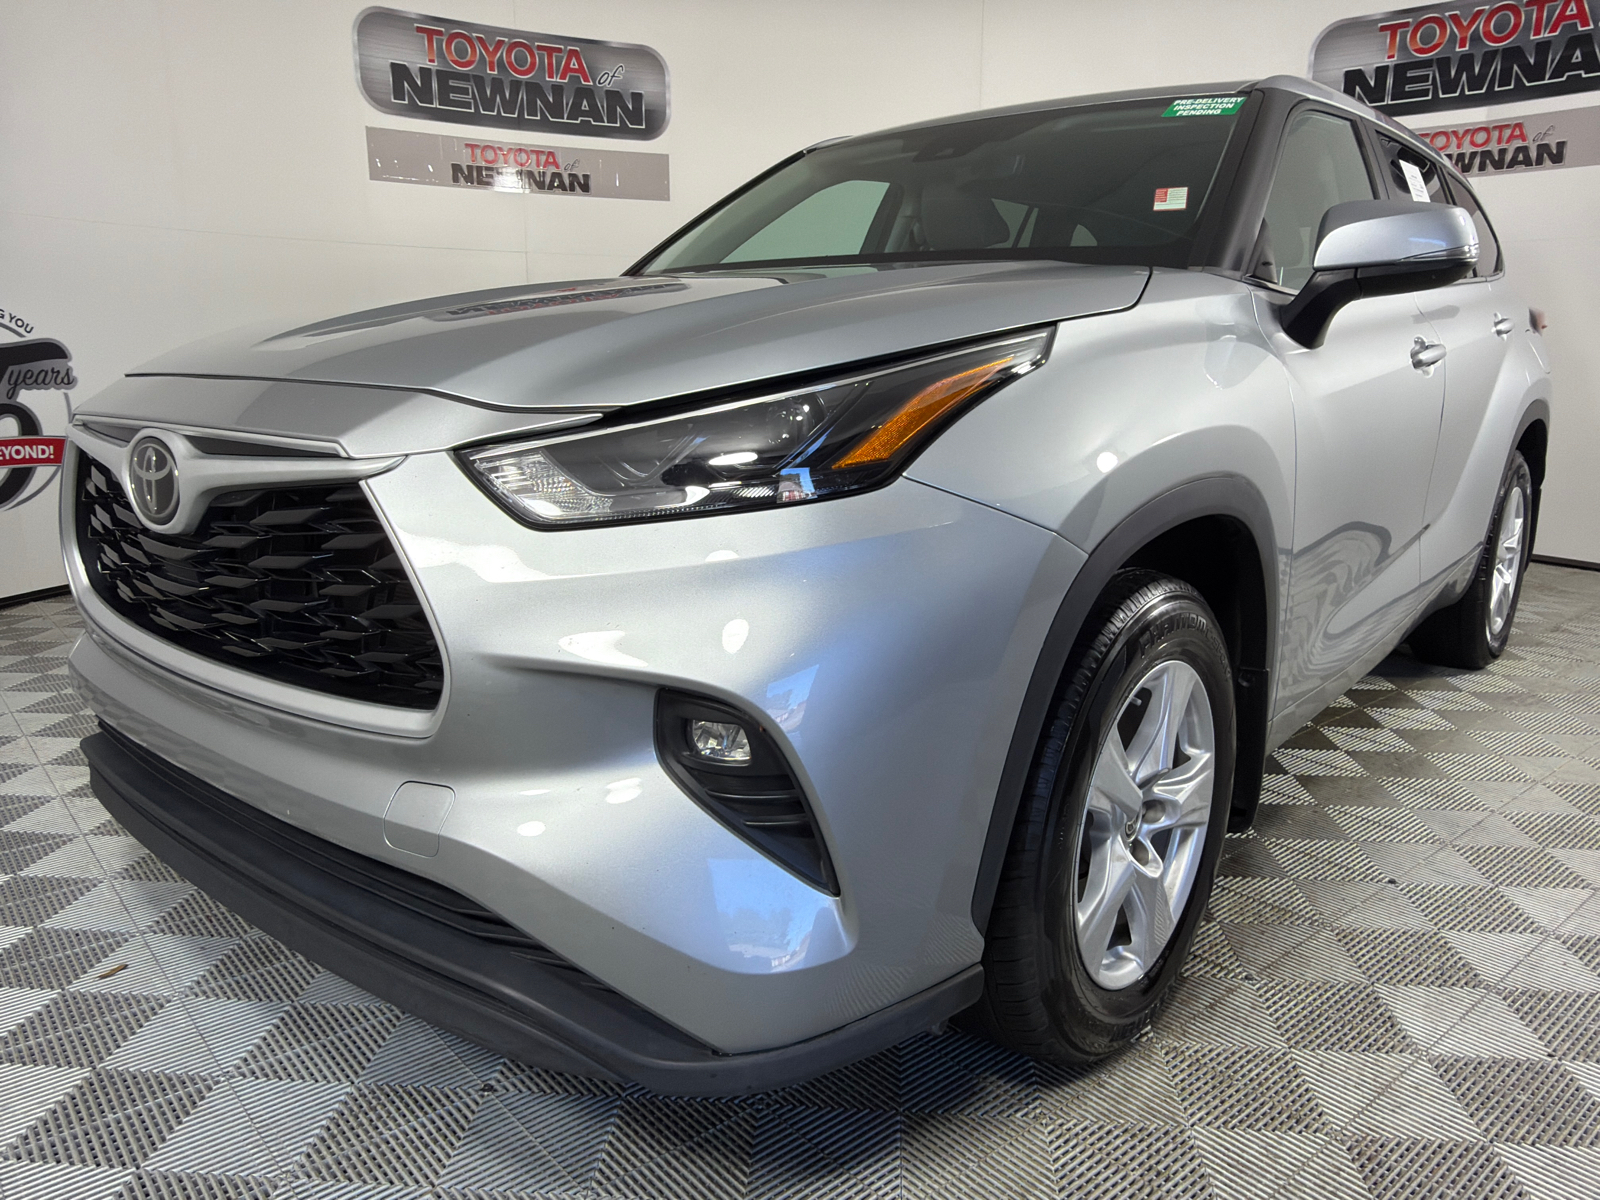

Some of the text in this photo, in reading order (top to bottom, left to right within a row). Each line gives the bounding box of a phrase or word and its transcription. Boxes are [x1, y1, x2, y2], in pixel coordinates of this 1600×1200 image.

[1378, 0, 1594, 61] TOYOTA
[414, 23, 625, 87] TOYOTA of
[389, 61, 646, 128] NEWNAN
[1173, 97, 1244, 105] PRE-DELIVERY
[1173, 103, 1235, 111] INSPECTION
[464, 143, 579, 172] TOYOTA of
[1444, 140, 1567, 174] WNAN
[451, 163, 591, 193] NENAN
[9, 312, 34, 334] YOU
[6, 366, 75, 400] years
